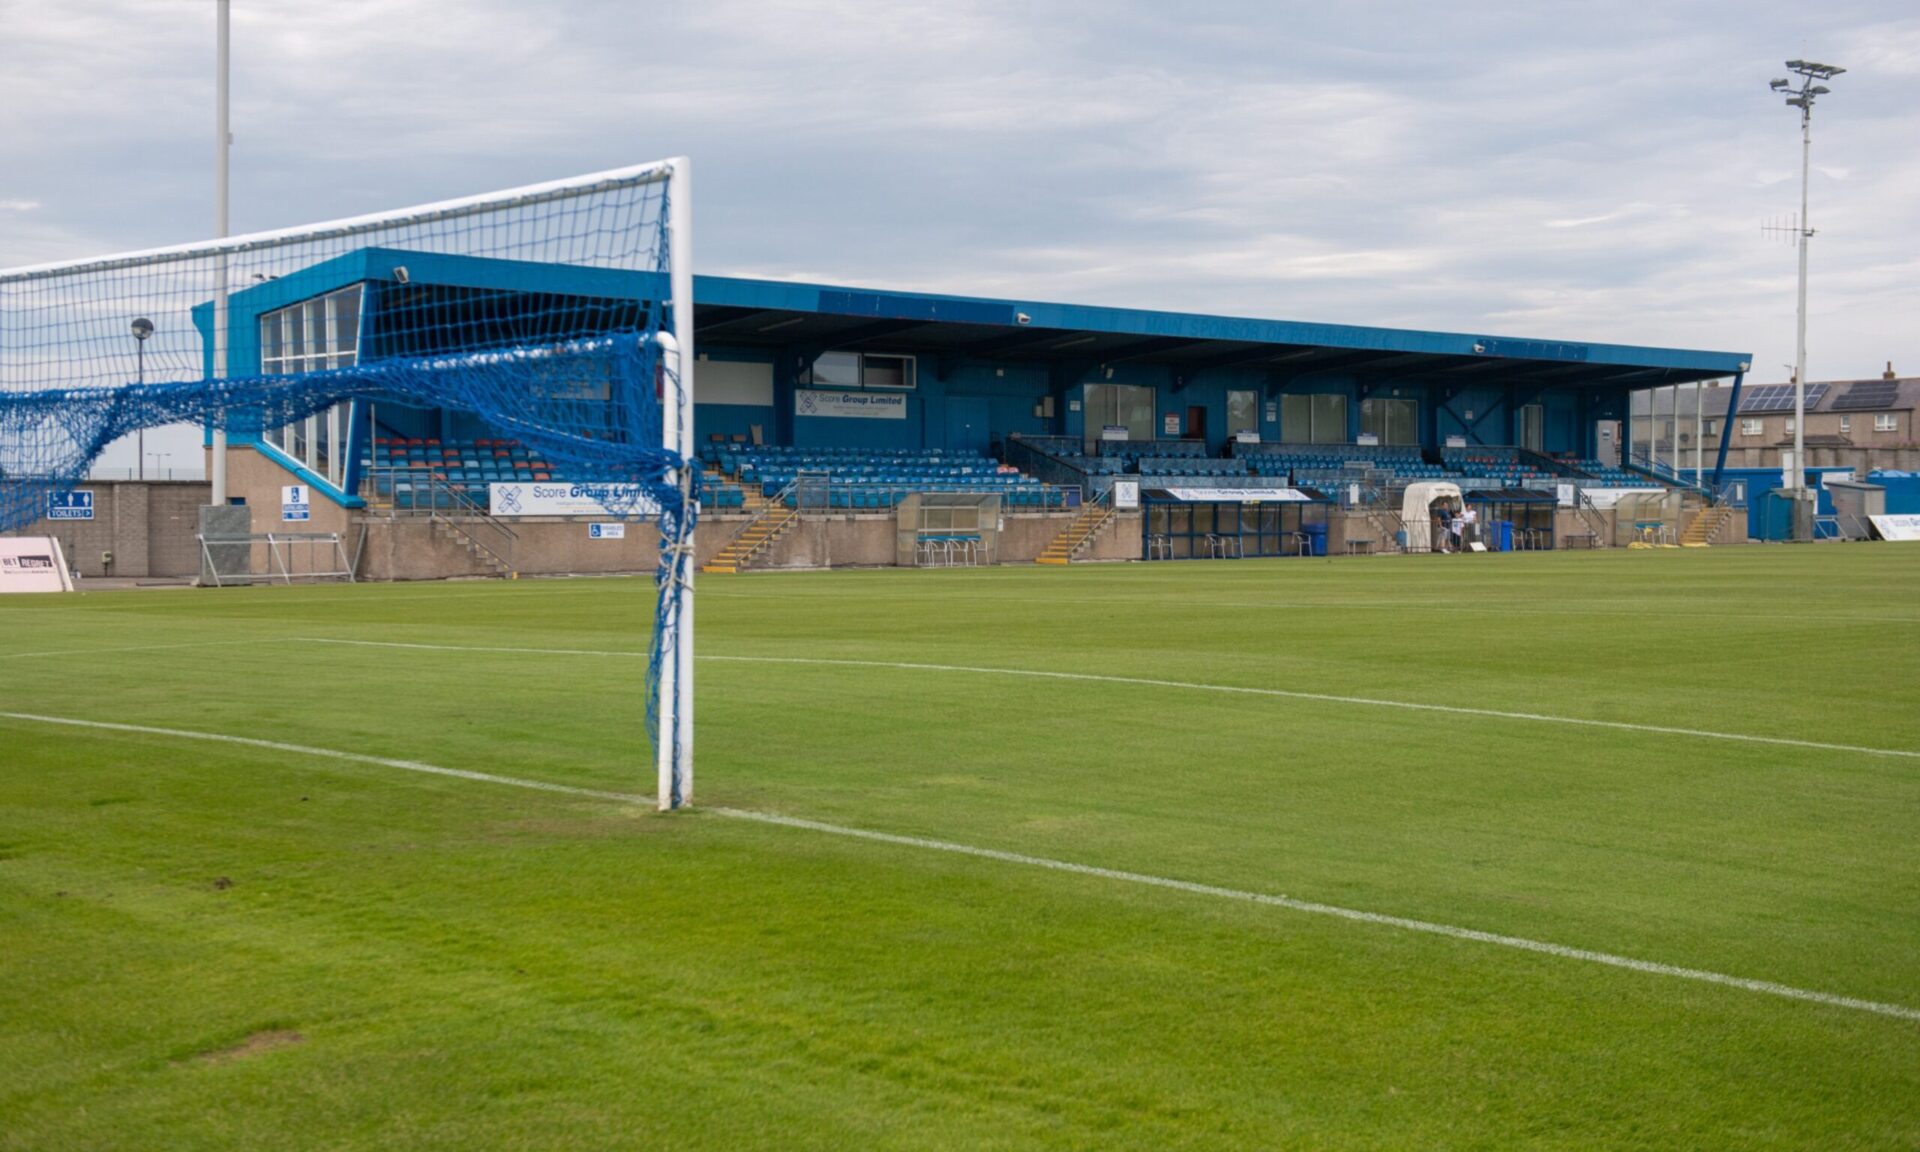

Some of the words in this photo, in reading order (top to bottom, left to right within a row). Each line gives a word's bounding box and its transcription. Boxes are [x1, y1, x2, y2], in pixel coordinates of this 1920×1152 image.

[1190, 319, 1259, 340] SPONSOR
[819, 393, 841, 403] Score
[842, 395, 868, 405] Group
[870, 396, 903, 405] Limited
[533, 486, 567, 498] Score
[570, 486, 609, 501] Group
[51, 510, 82, 518] TOILETS
[2, 558, 17, 566] BET
